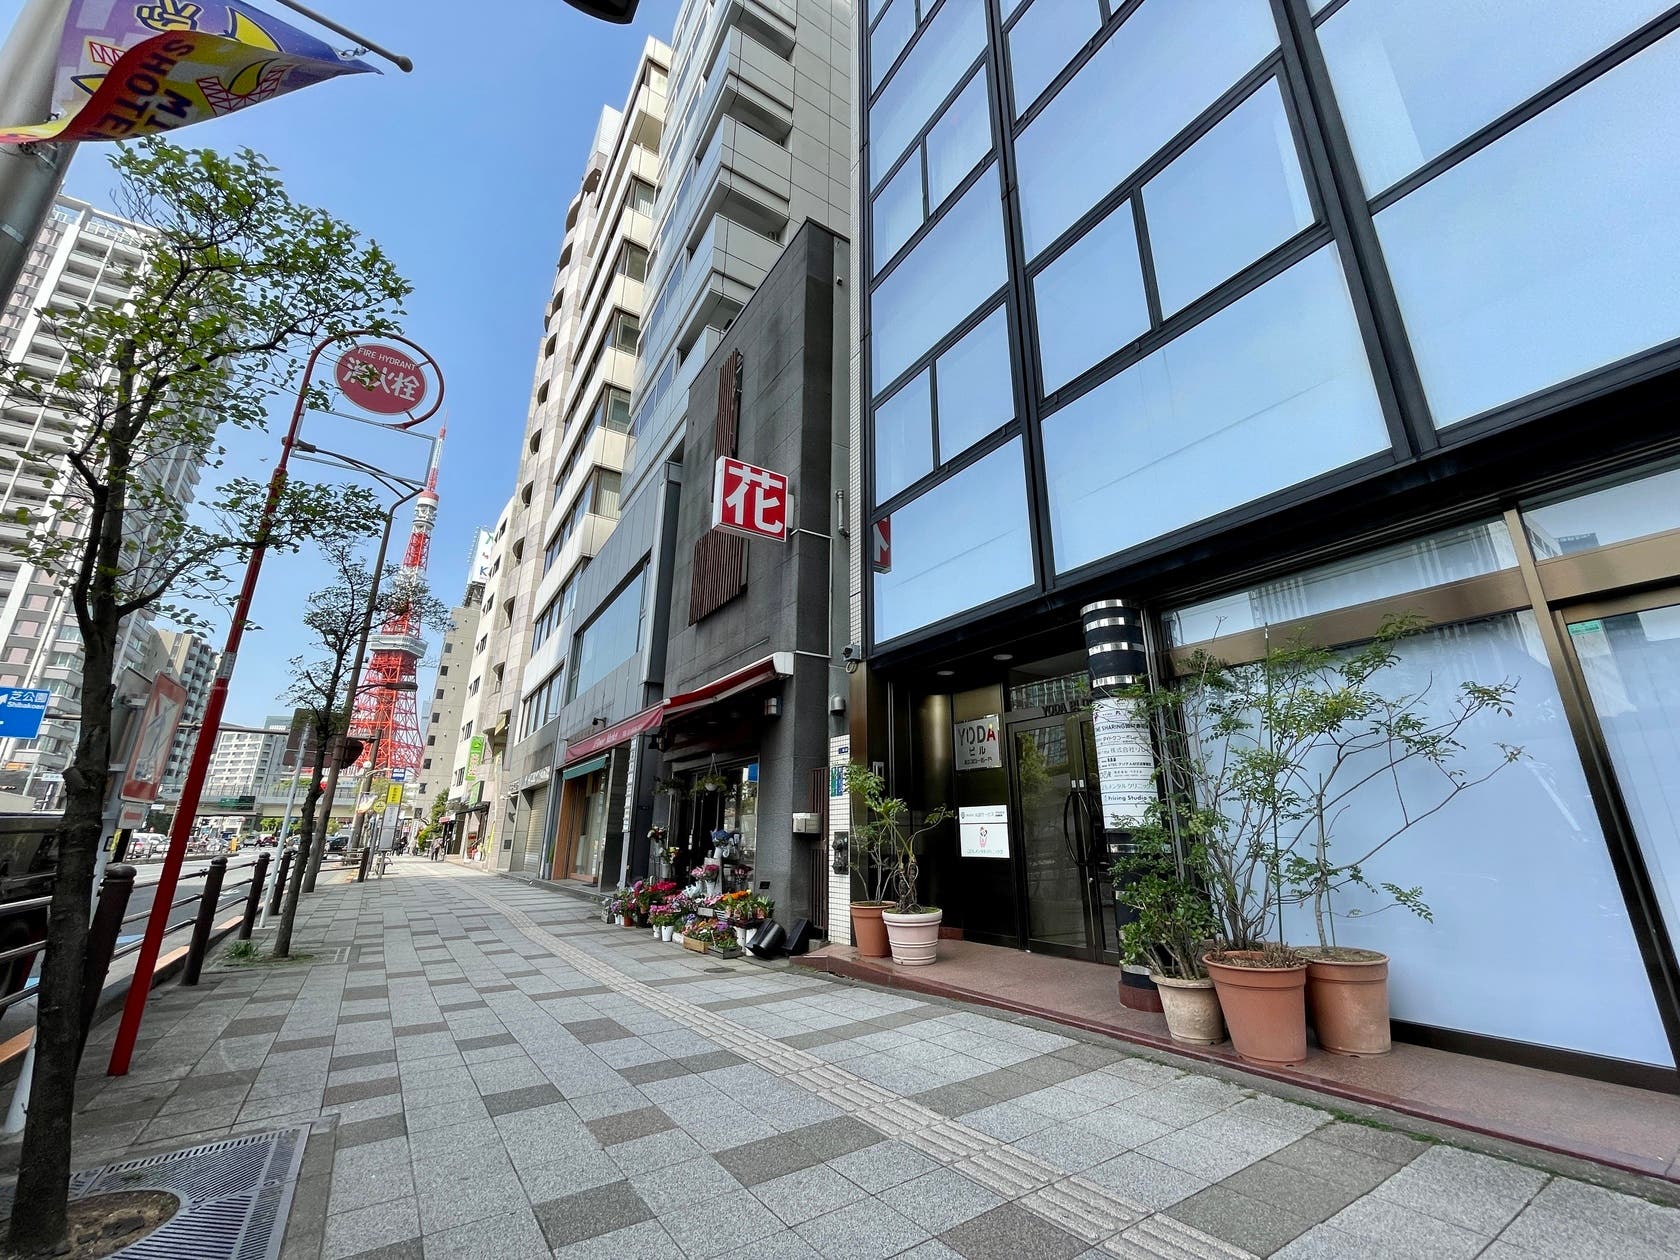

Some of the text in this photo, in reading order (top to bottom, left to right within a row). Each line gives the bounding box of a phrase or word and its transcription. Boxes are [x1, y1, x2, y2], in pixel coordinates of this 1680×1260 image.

[357, 347, 416, 371] FIRE HYDRANT
[342, 356, 420, 401] 消火栓
[725, 465, 783, 534] 花
[1041, 702, 1067, 717] YODA
[957, 724, 996, 746] YODA
[968, 745, 986, 757] ビル
